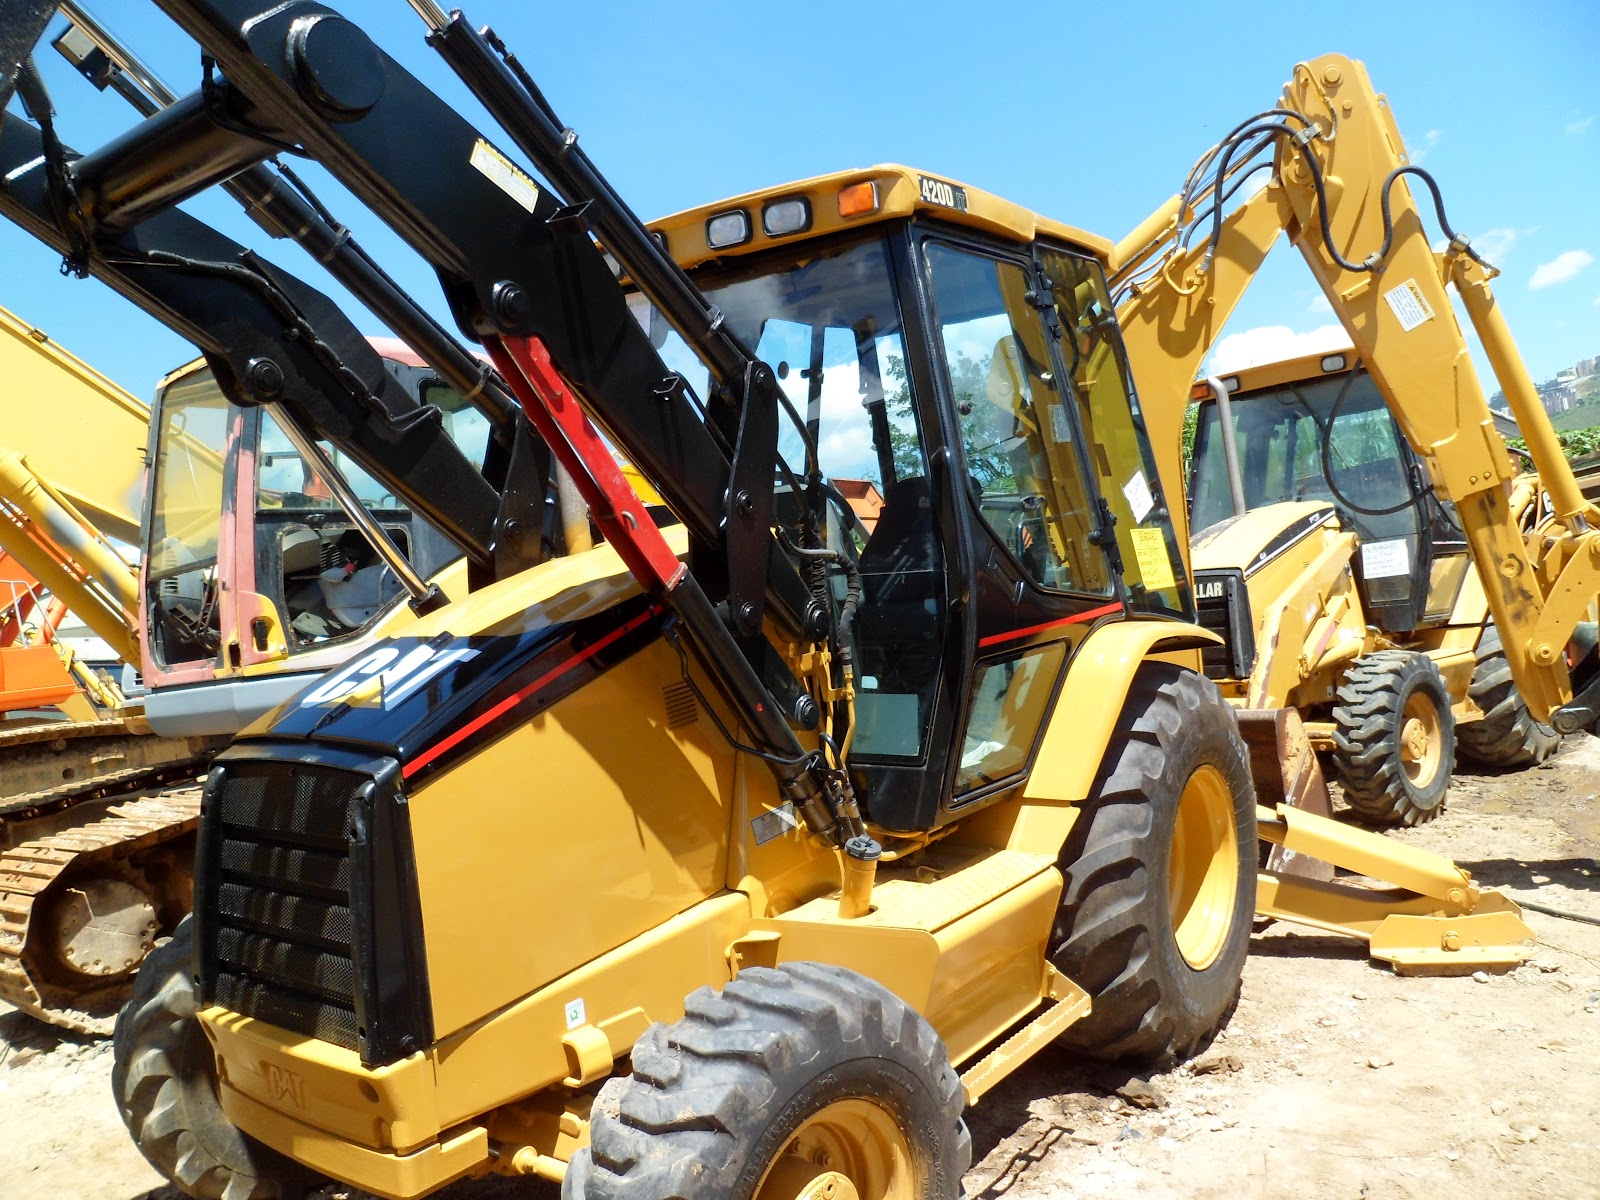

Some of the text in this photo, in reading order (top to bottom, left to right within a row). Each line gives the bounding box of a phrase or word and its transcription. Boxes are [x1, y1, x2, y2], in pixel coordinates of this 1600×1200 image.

[922, 179, 954, 207] 420D
[1412, 290, 1429, 315] WARNING
[300, 644, 482, 711] CAT
